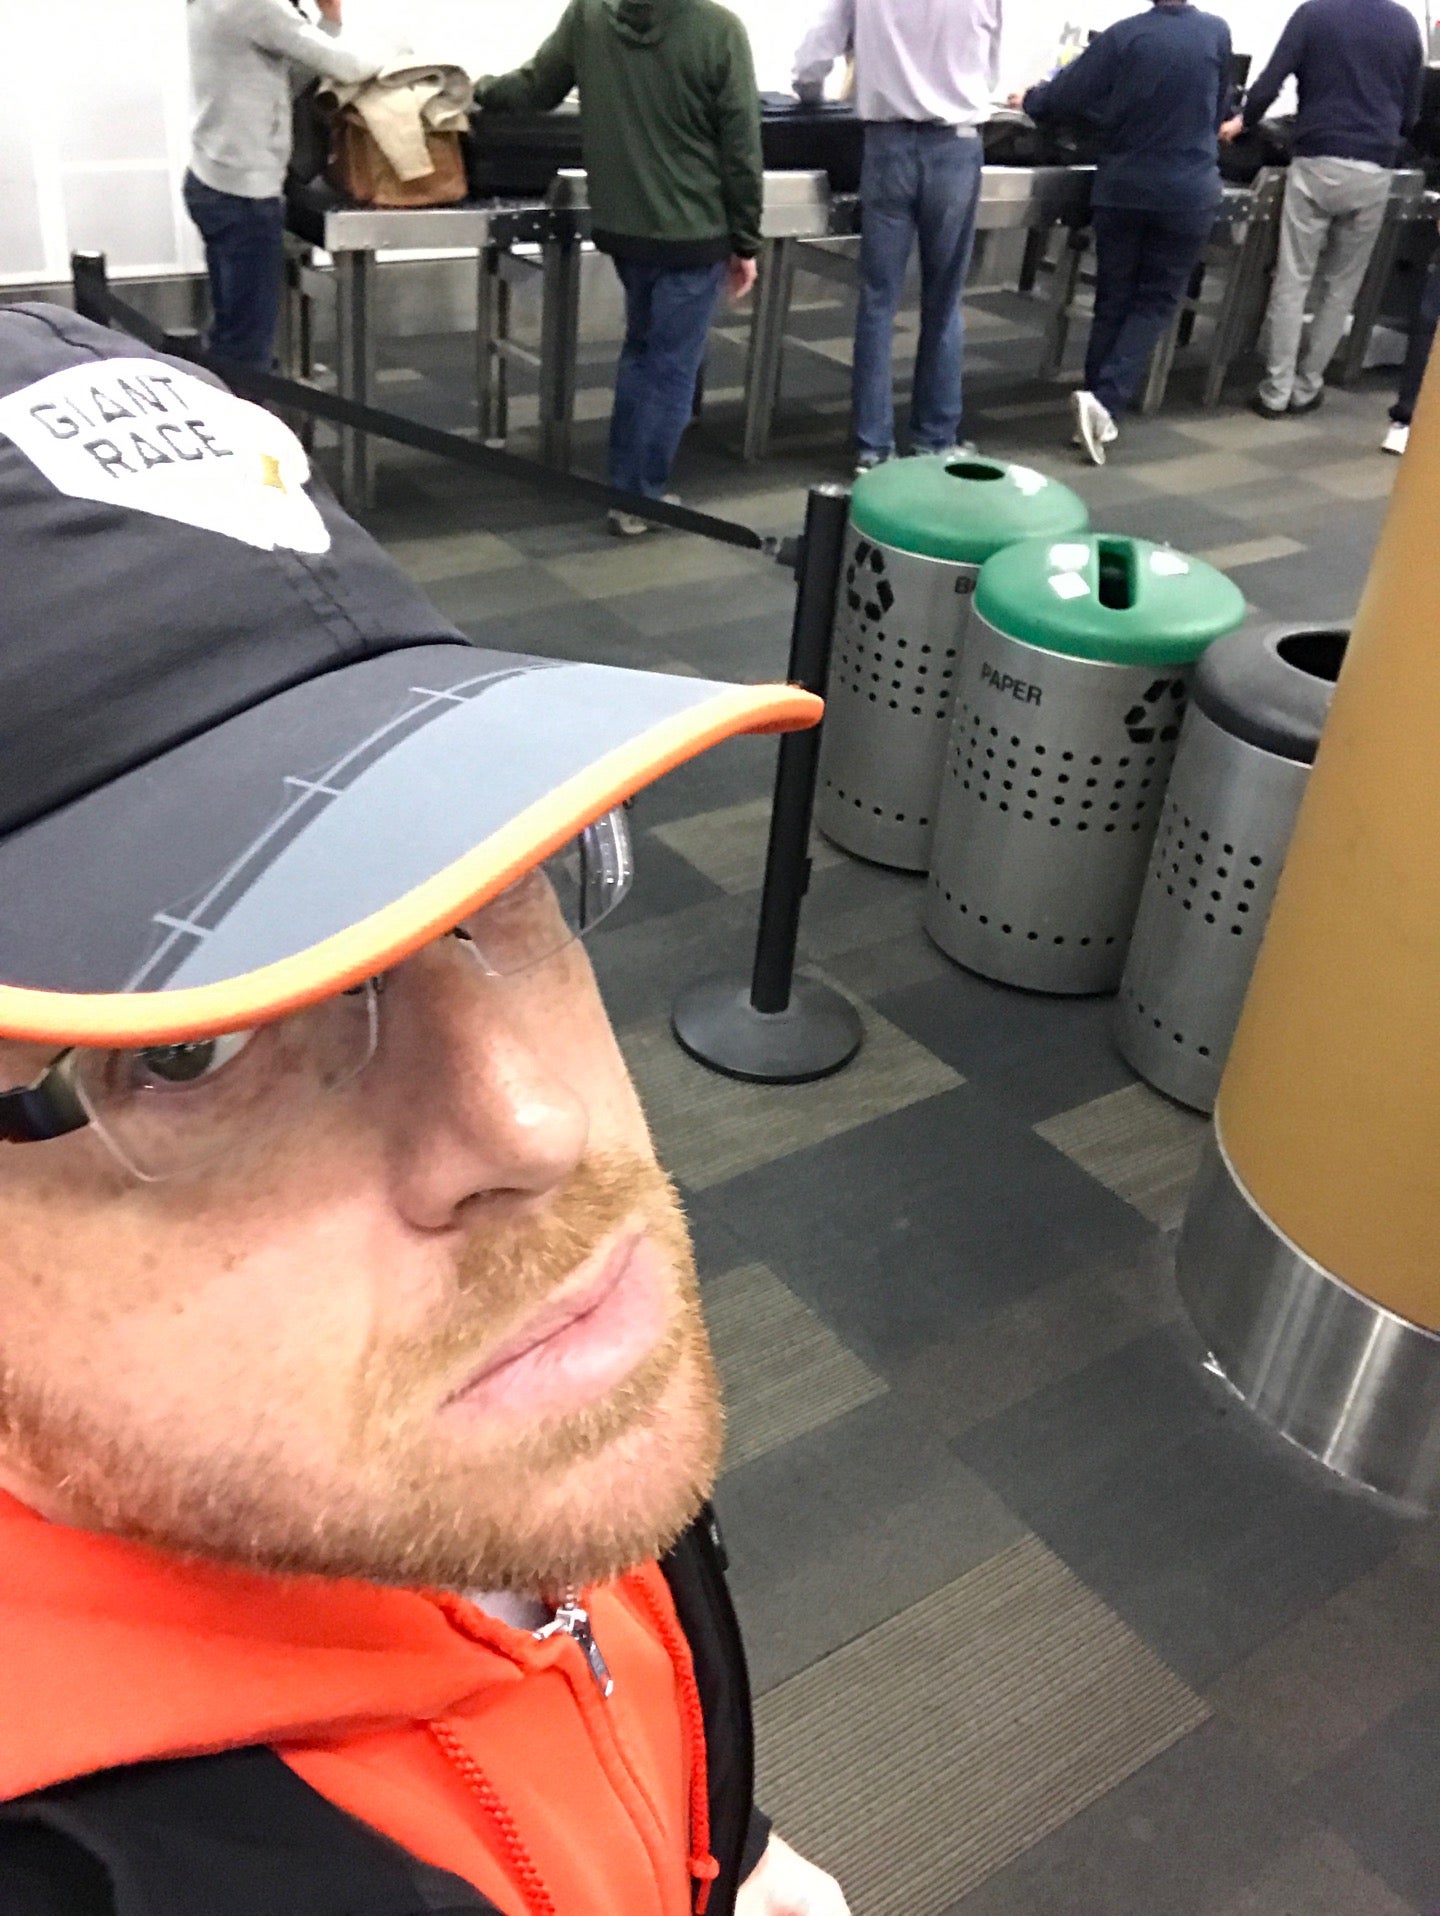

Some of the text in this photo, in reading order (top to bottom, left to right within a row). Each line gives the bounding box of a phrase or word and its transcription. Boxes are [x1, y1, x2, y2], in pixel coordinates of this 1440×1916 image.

[30, 376, 189, 440] GIANT
[83, 420, 234, 479] RACE
[981, 661, 1043, 707] PAPER
